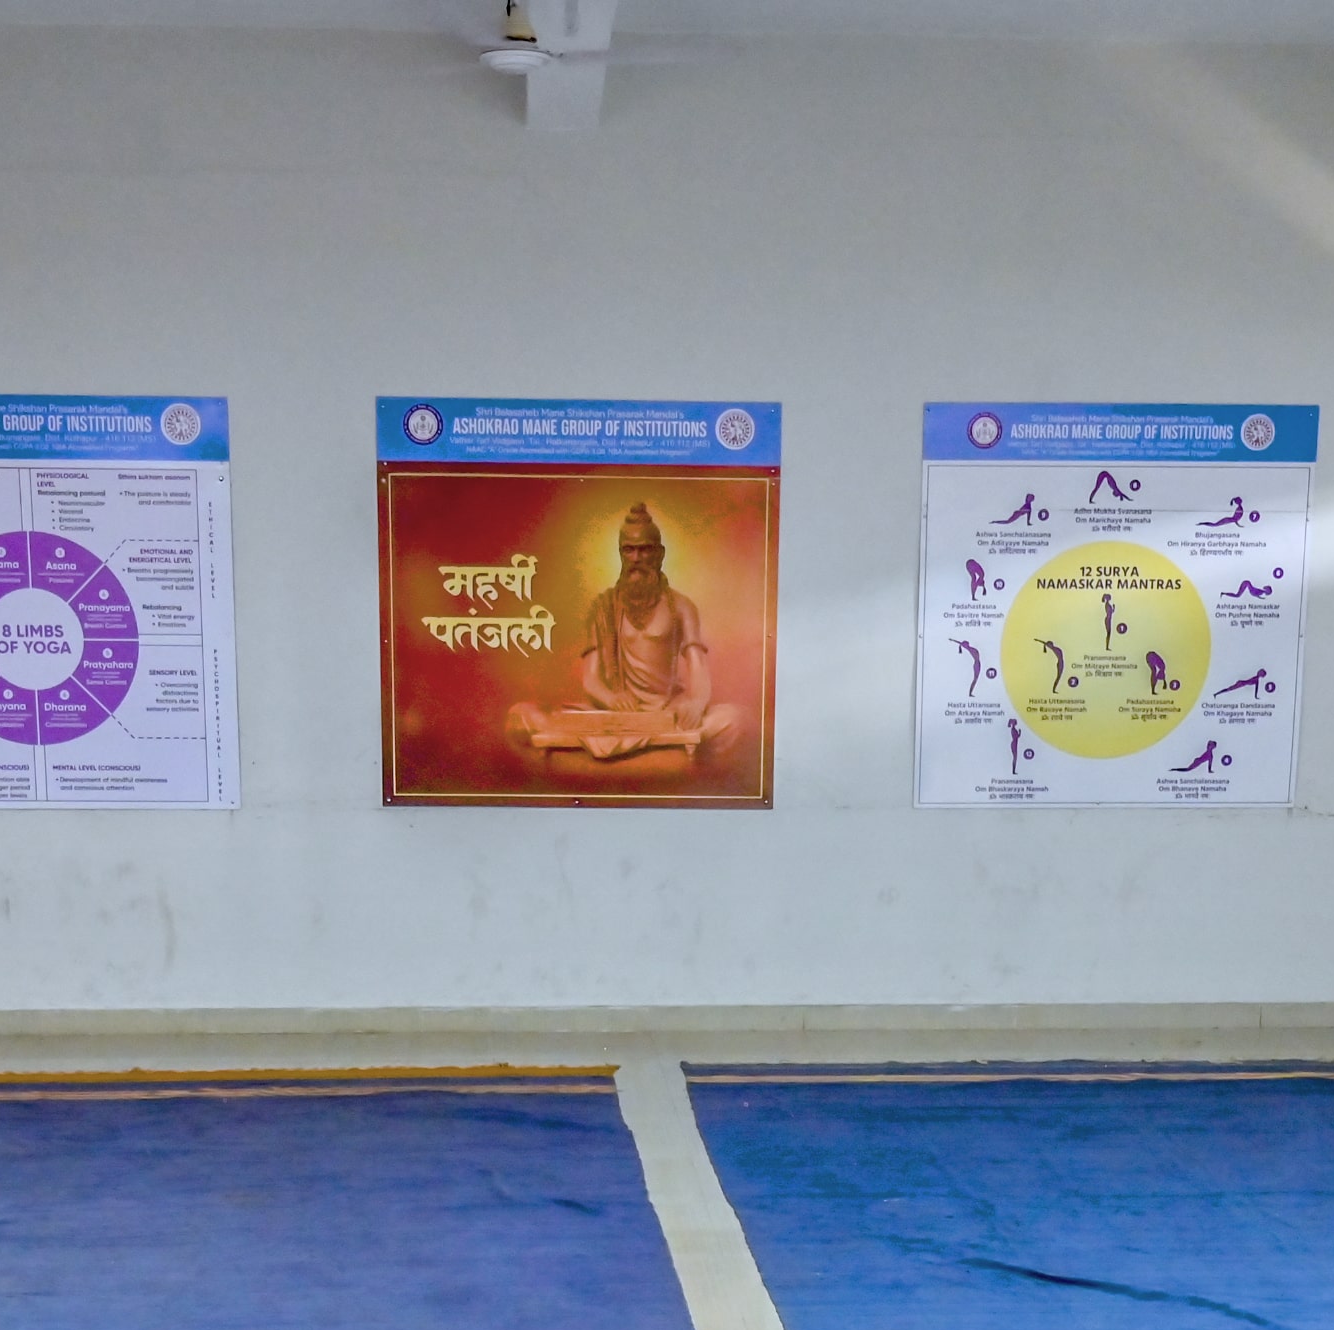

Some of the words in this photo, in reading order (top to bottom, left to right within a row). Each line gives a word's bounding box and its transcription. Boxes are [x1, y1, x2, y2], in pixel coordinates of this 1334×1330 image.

[541, 408, 565, 417] Mane
[3, 415, 44, 432] GROUP
[48, 415, 63, 432] OF
[67, 416, 152, 433] INSTITUTIONS
[452, 417, 519, 435] ASHOKRAO
[522, 419, 558, 435] MANE
[561, 419, 602, 436] GROUP
[605, 420, 620, 437] OF
[624, 421, 707, 438] INSTITUTIONS
[1011, 424, 1069, 439] ASHOKRAO
[1072, 424, 1103, 439] MANE
[1105, 424, 1141, 439] GROUP
[1144, 424, 1158, 440] OF
[1160, 424, 1234, 440] INSTITUTIONS
[45, 561, 77, 571] Asana
[1079, 566, 1092, 577] 12
[1096, 566, 1139, 577] SURYA
[437, 553, 539, 611] महर्षी
[1036, 579, 1113, 590] NAMASKAR
[1117, 579, 1182, 590] MANTRAS
[79, 603, 131, 614] Pranayama
[2, 624, 12, 637] 8
[17, 624, 64, 638] LIMBS
[421, 604, 557, 658] पतंजली
[22, 641, 72, 654] YOGA
[83, 661, 134, 671] Pratyahara
[44, 702, 87, 712] Dharana
[1201, 702, 1239, 710] Chaturanga
[1216, 710, 1244, 718] Khagaye
